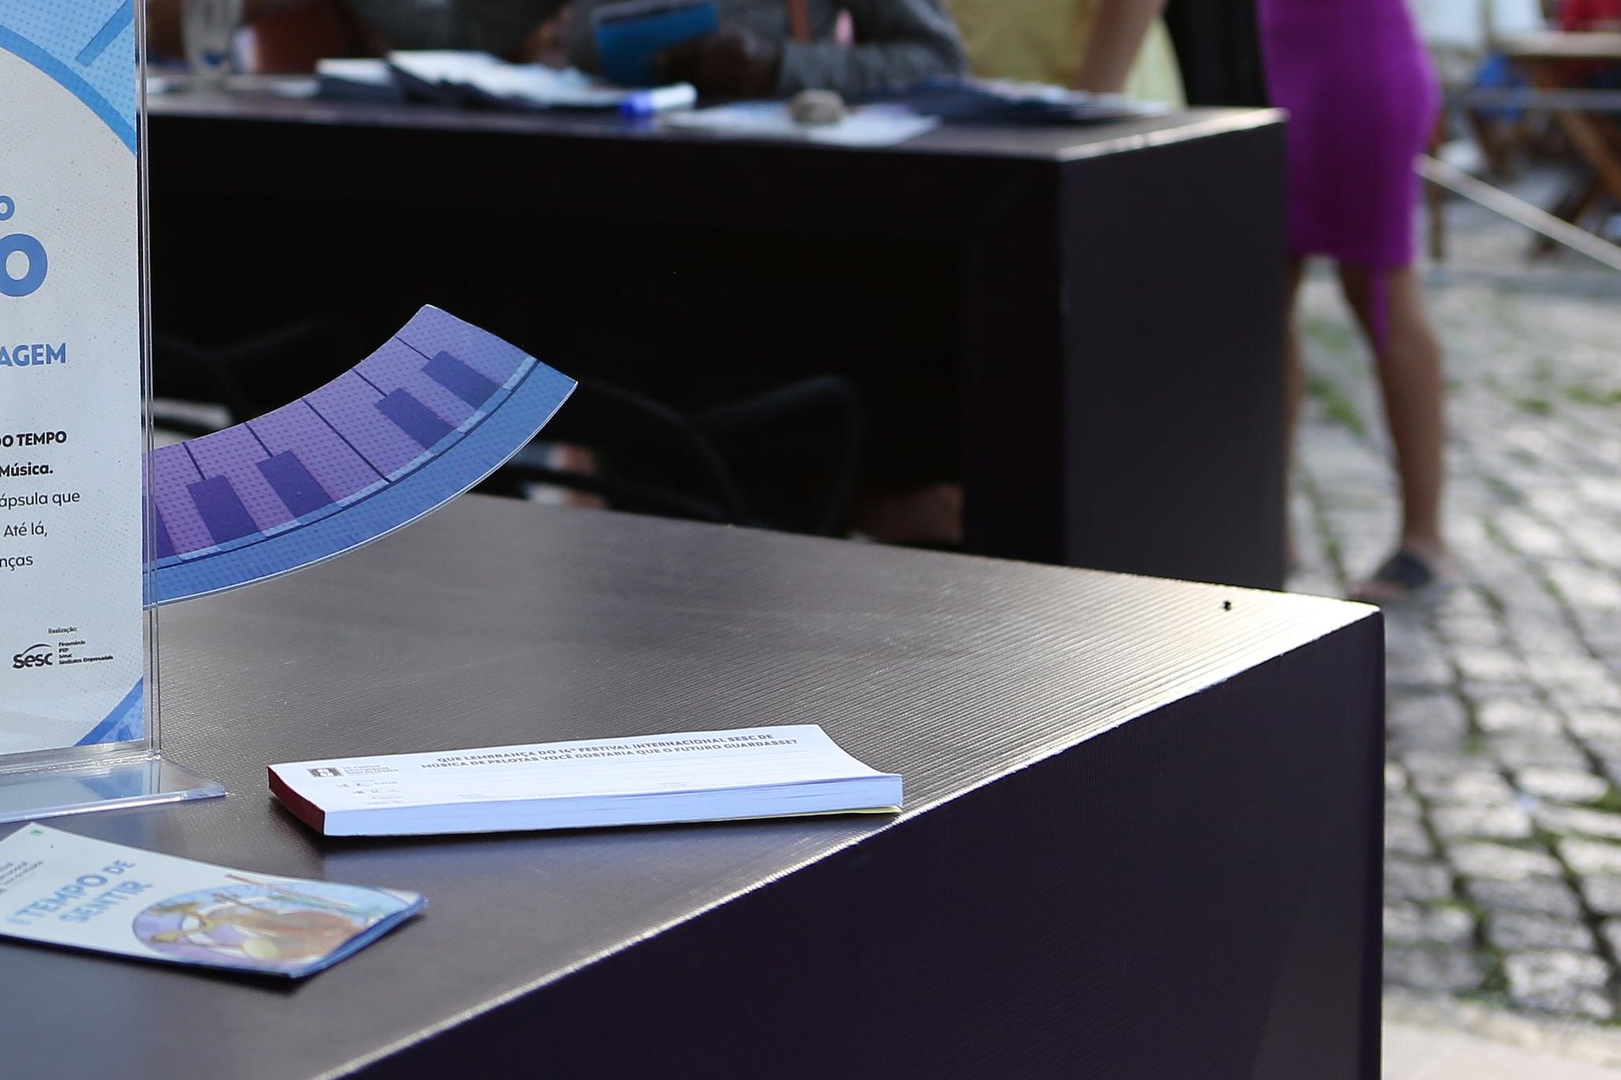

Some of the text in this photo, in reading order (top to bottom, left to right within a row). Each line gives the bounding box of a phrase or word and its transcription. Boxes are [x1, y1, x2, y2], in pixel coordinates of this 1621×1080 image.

[16, 430, 68, 447] TEMPO
[52, 492, 81, 507] que
[3, 522, 28, 538] Até
[31, 521, 48, 537] lá,
[464, 751, 538, 761] LEMBRANÇA
[578, 744, 632, 753] FESTIVAL
[632, 737, 726, 750] INTERNACIONAL
[727, 735, 759, 743] SESC
[488, 757, 540, 765] PELOTAS
[576, 750, 635, 759] GOSTARIA
[636, 748, 663, 756] QUE
[675, 744, 723, 753] FUTURO
[723, 739, 798, 749] GUARDASSE?
[14, 875, 108, 918] TEMPO
